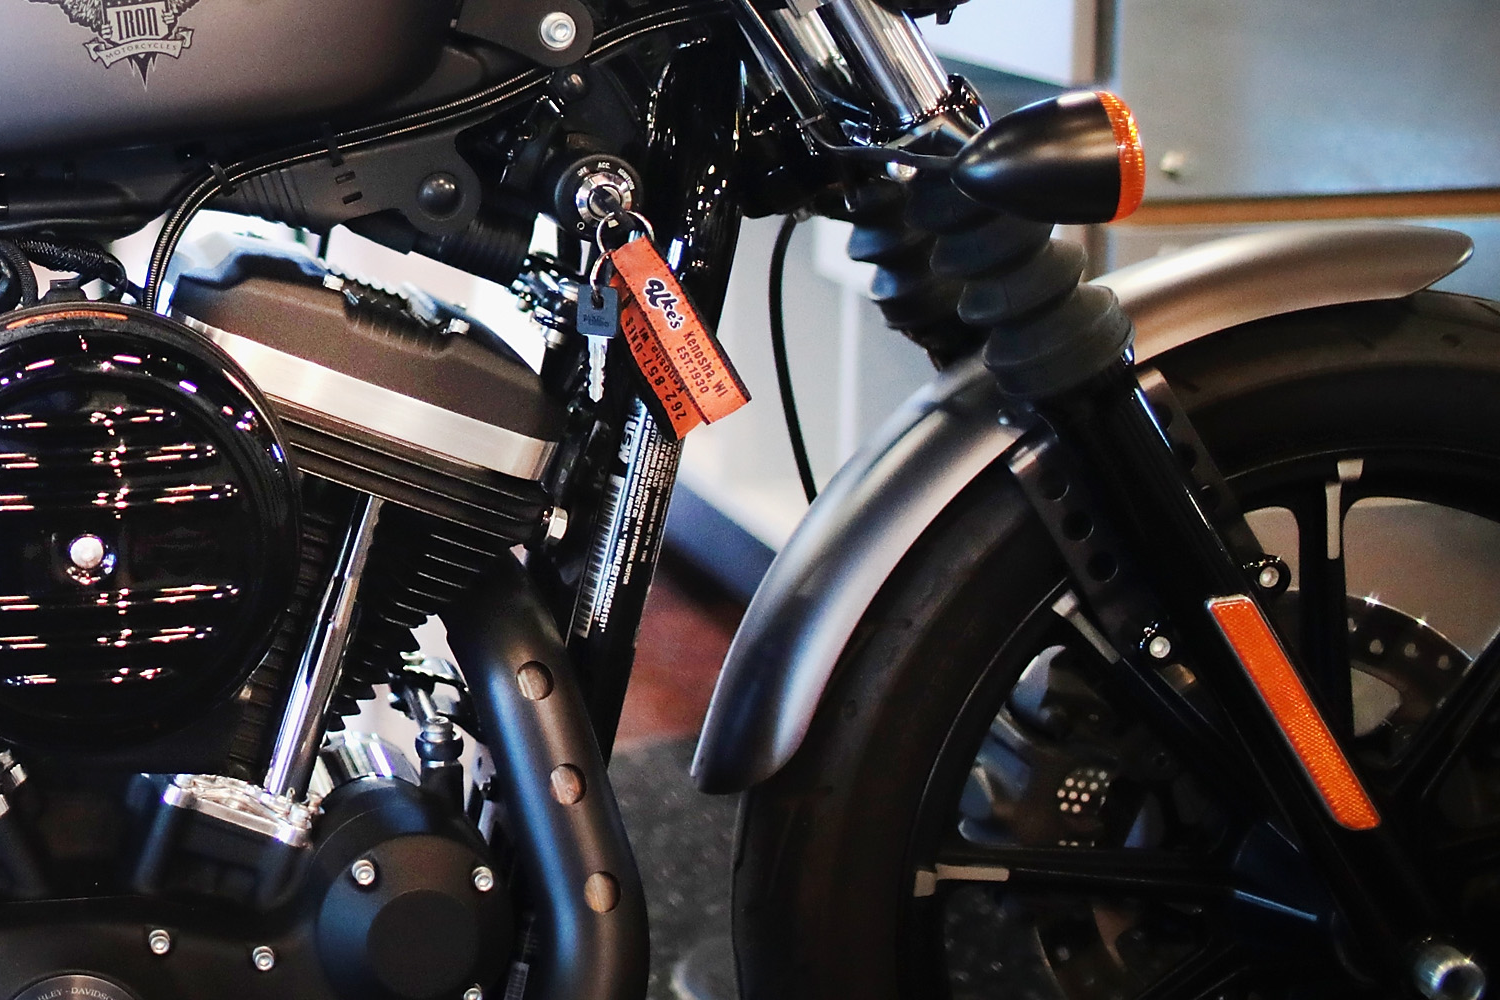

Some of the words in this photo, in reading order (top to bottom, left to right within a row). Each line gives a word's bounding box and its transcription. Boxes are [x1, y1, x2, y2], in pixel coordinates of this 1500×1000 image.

[116, 7, 159, 40] IRON
[106, 43, 177, 59] MOTORCYCLES
[639, 327, 650, 342] WI
[625, 316, 687, 420] 262-857-UKES
[677, 347, 709, 393] EST.1930
[683, 331, 715, 383] Kenosha,
[713, 380, 728, 398] WI
[644, 477, 652, 489] ALL
[633, 485, 644, 508] EFFECT
[636, 489, 649, 525] APPLICABLE
[628, 535, 638, 562] FEDERAL
[622, 562, 632, 584] MOTOR
[37, 988, 63, 1000] RLEY
[70, 987, 116, 1000] DAVIDSO
